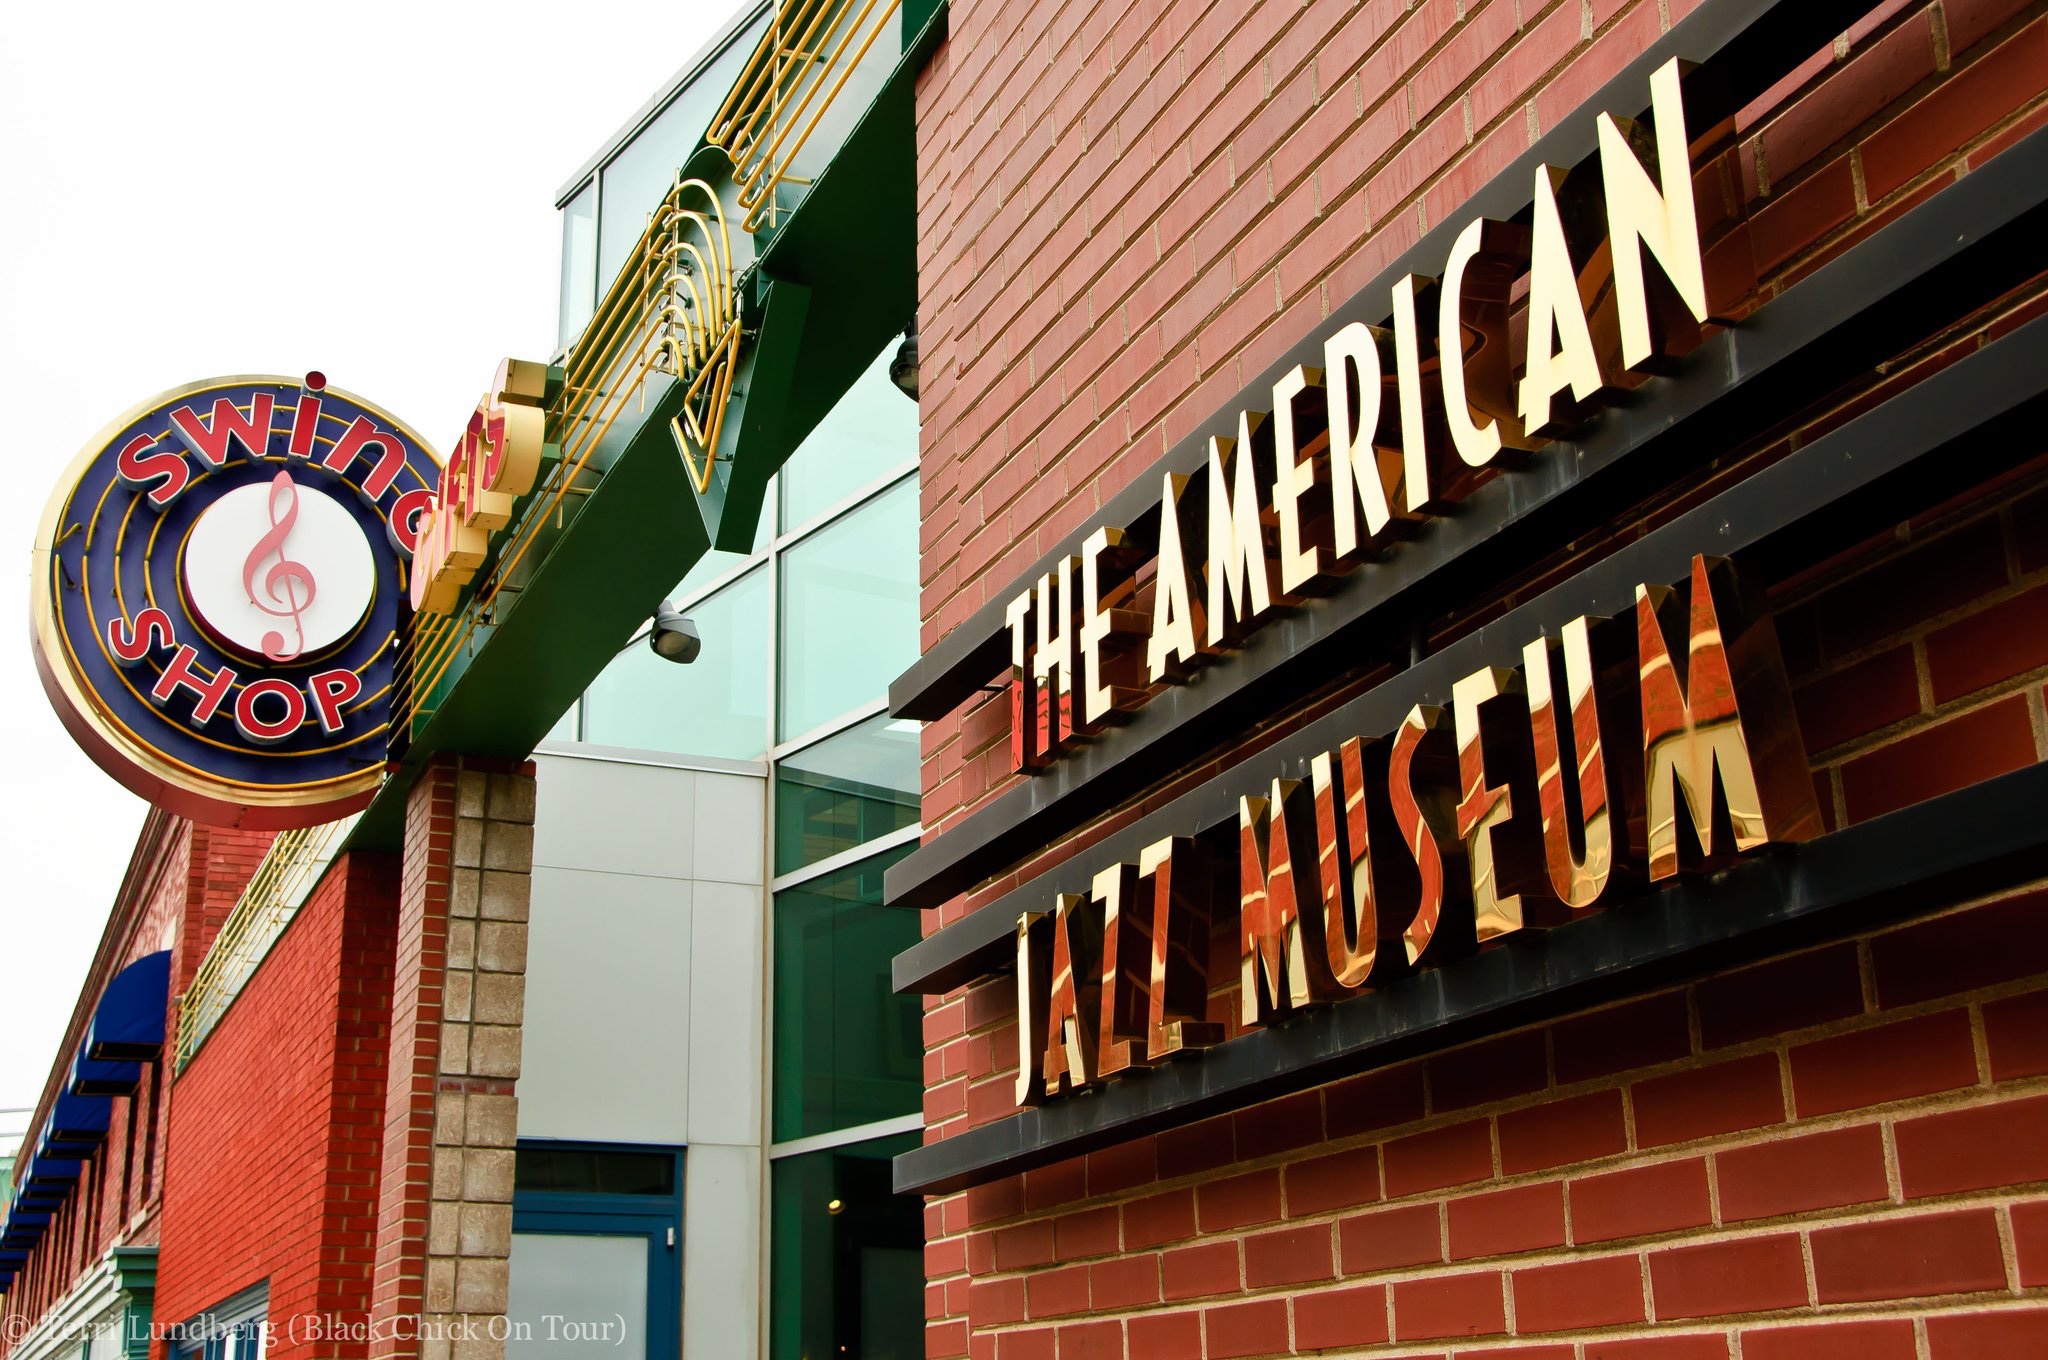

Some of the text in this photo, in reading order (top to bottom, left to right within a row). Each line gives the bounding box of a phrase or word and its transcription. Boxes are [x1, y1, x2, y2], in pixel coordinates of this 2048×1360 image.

[107, 607, 363, 746] SHOP
[1005, 55, 1708, 775] THE AMERICAN
[1015, 553, 1770, 1106] JAZZ MUSEUM
